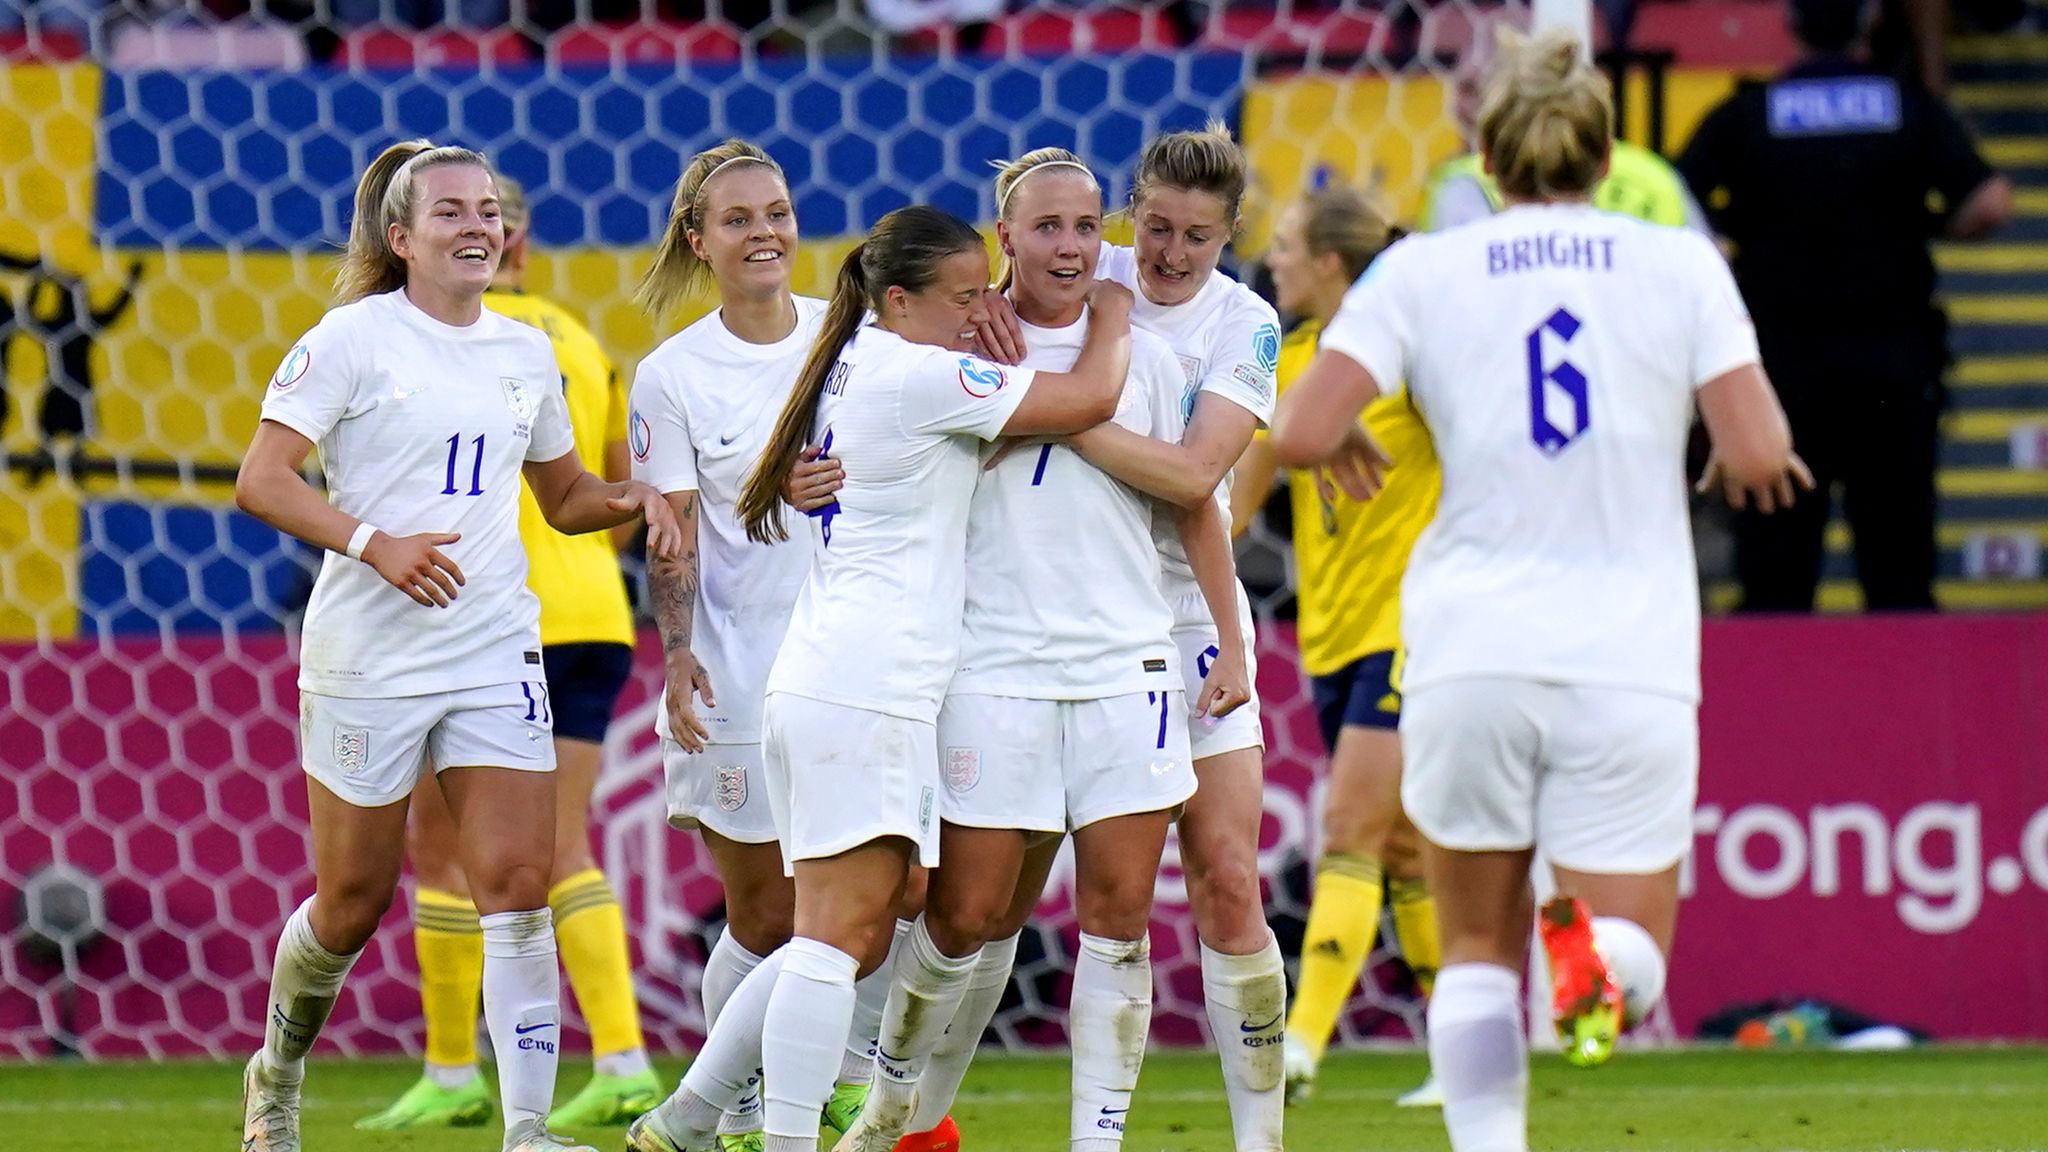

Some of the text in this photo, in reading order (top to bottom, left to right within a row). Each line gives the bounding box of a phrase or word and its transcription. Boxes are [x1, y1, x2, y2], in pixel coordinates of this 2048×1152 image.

[1773, 83, 1888, 130] POLICE
[1488, 233, 1615, 276] BRIGHT
[1526, 308, 1590, 456] 6
[440, 431, 485, 496] 11
[517, 1037, 555, 1054] Eng
